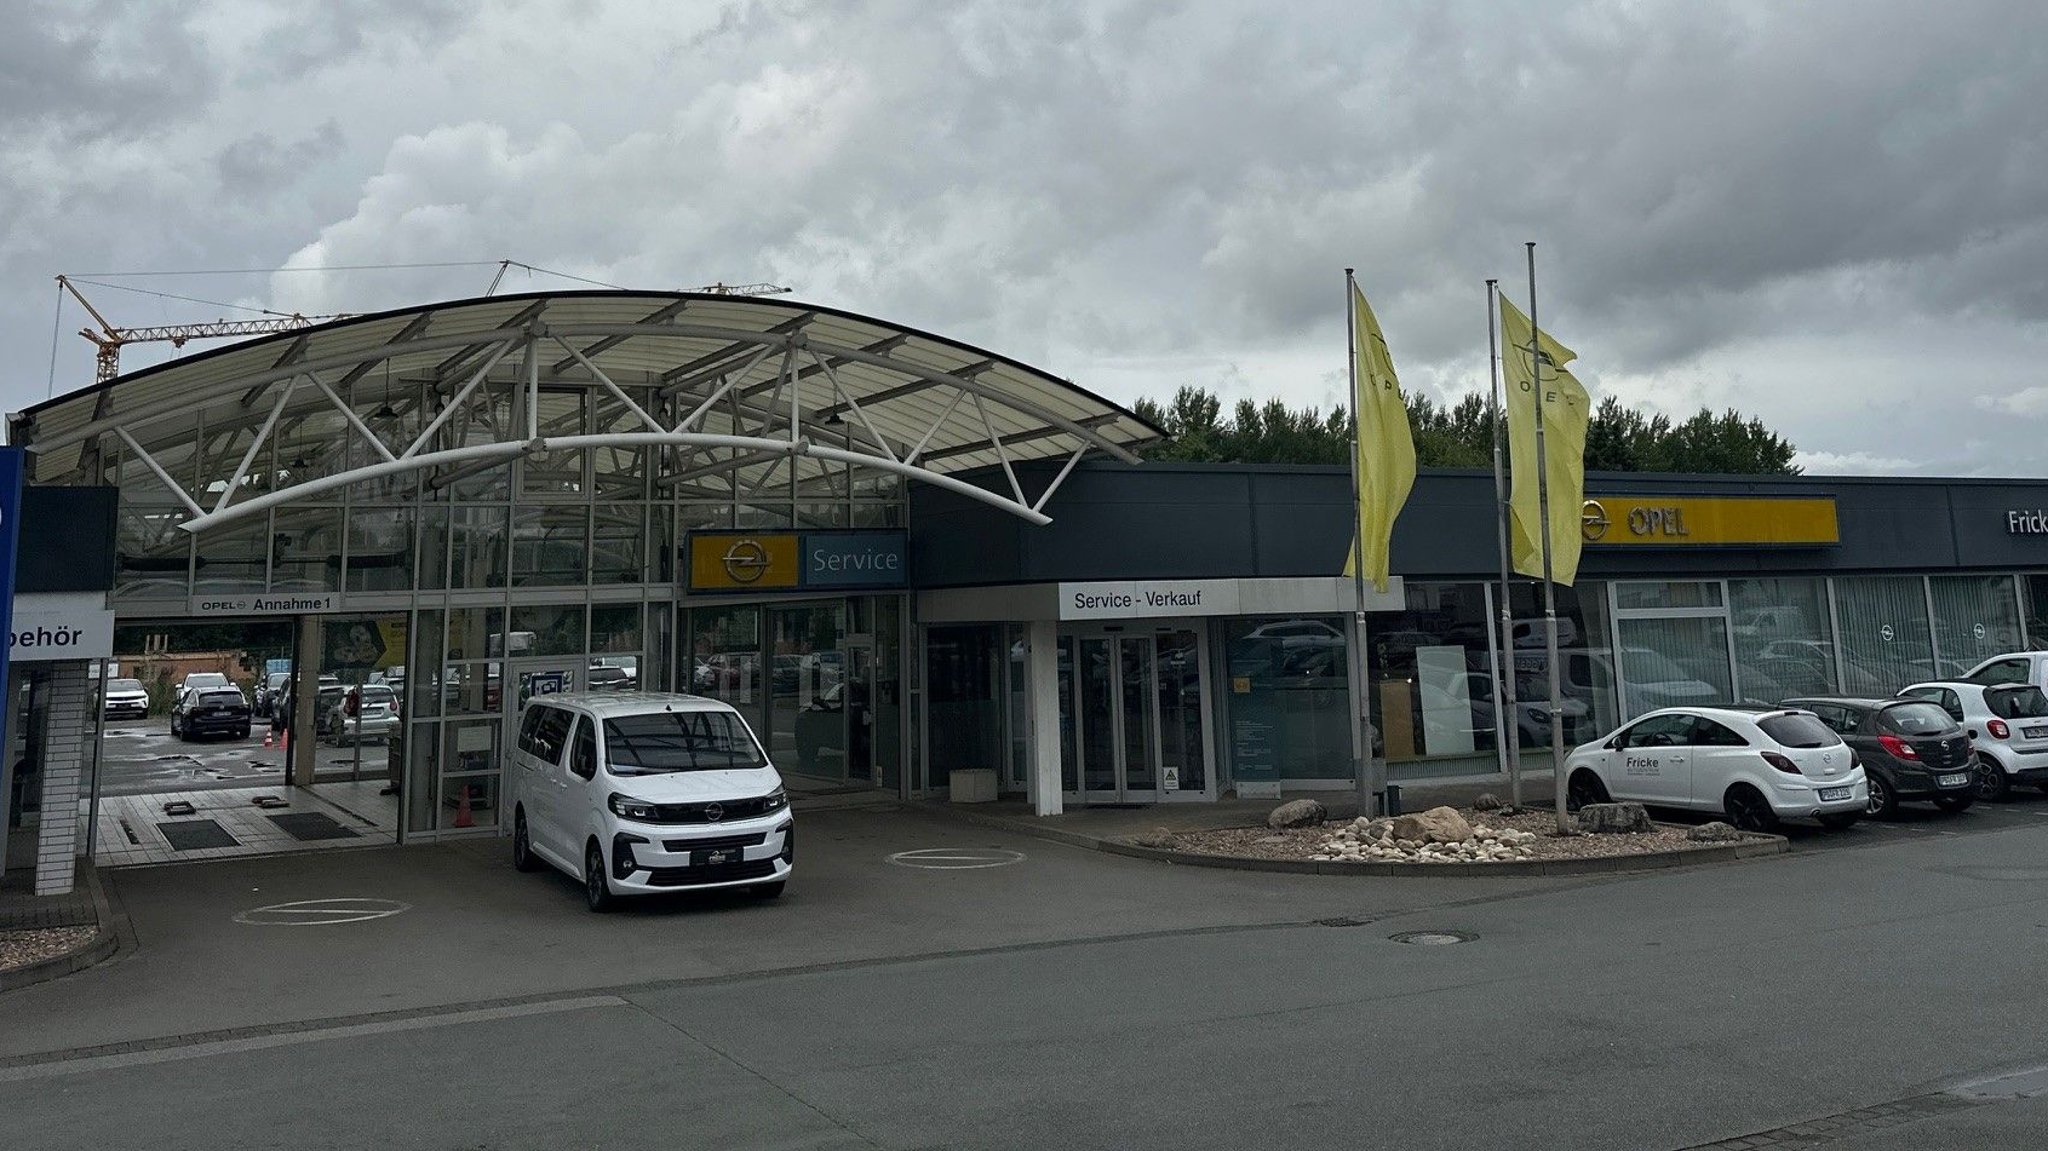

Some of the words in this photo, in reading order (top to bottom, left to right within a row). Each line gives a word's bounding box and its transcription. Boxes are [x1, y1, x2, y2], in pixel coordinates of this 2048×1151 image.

[1628, 507, 1689, 536] OPEL
[2008, 509, 2048, 533] Frick
[813, 548, 898, 571] Service
[201, 602, 236, 610] OPEL
[253, 598, 322, 610] Annahme
[325, 597, 331, 608] 1
[1075, 592, 1132, 609] Service
[1145, 590, 1201, 606] Verkauf
[1626, 757, 1659, 768] Fricke
